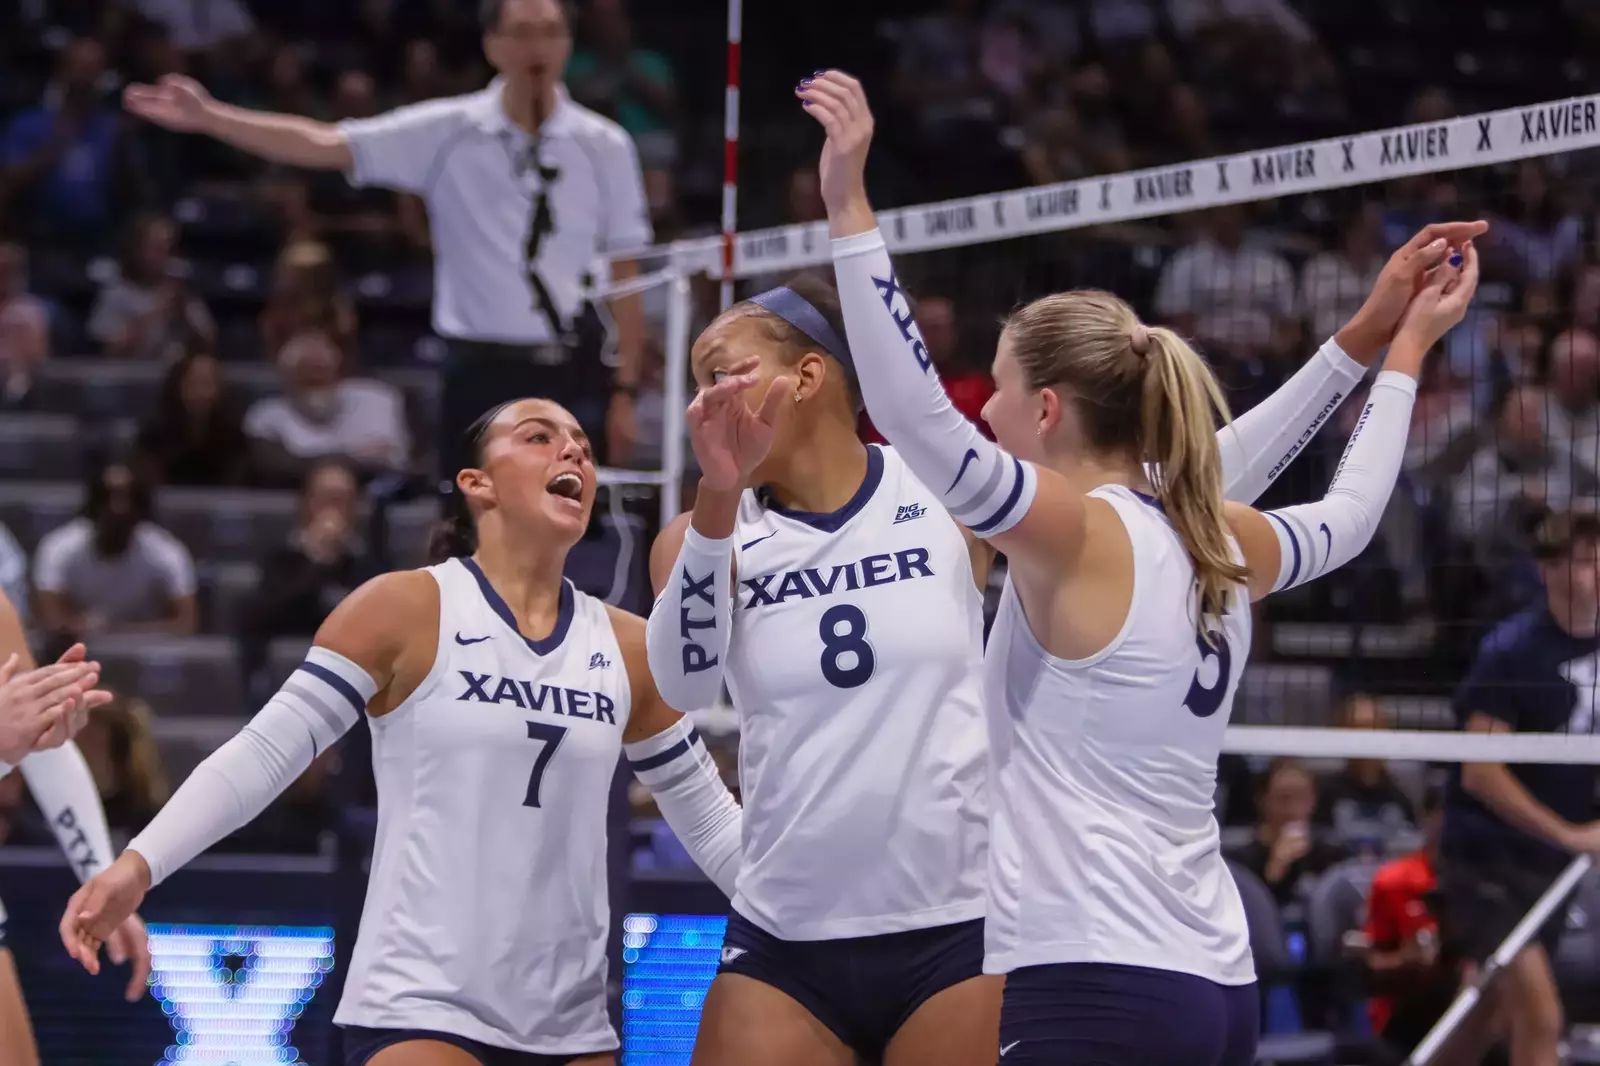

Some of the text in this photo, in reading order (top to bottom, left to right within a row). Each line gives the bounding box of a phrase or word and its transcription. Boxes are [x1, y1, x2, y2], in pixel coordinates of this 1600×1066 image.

[1216, 162, 1230, 193] X
[1252, 148, 1317, 186] XAVIER
[1341, 141, 1355, 173] X
[1379, 125, 1449, 167] XAVIER
[1476, 116, 1492, 151] X
[1520, 101, 1596, 145] XAVIER
[871, 264, 933, 376] PTX
[1267, 391, 1343, 481] MUSKETEERS
[894, 507, 928, 521] EAST
[897, 502, 919, 514] BIG
[681, 562, 719, 677] PTX
[741, 546, 936, 610] XAVIER
[818, 603, 878, 690] 8
[455, 670, 617, 726] XAVIER
[521, 720, 570, 809] 7
[56, 804, 100, 882] PTX
